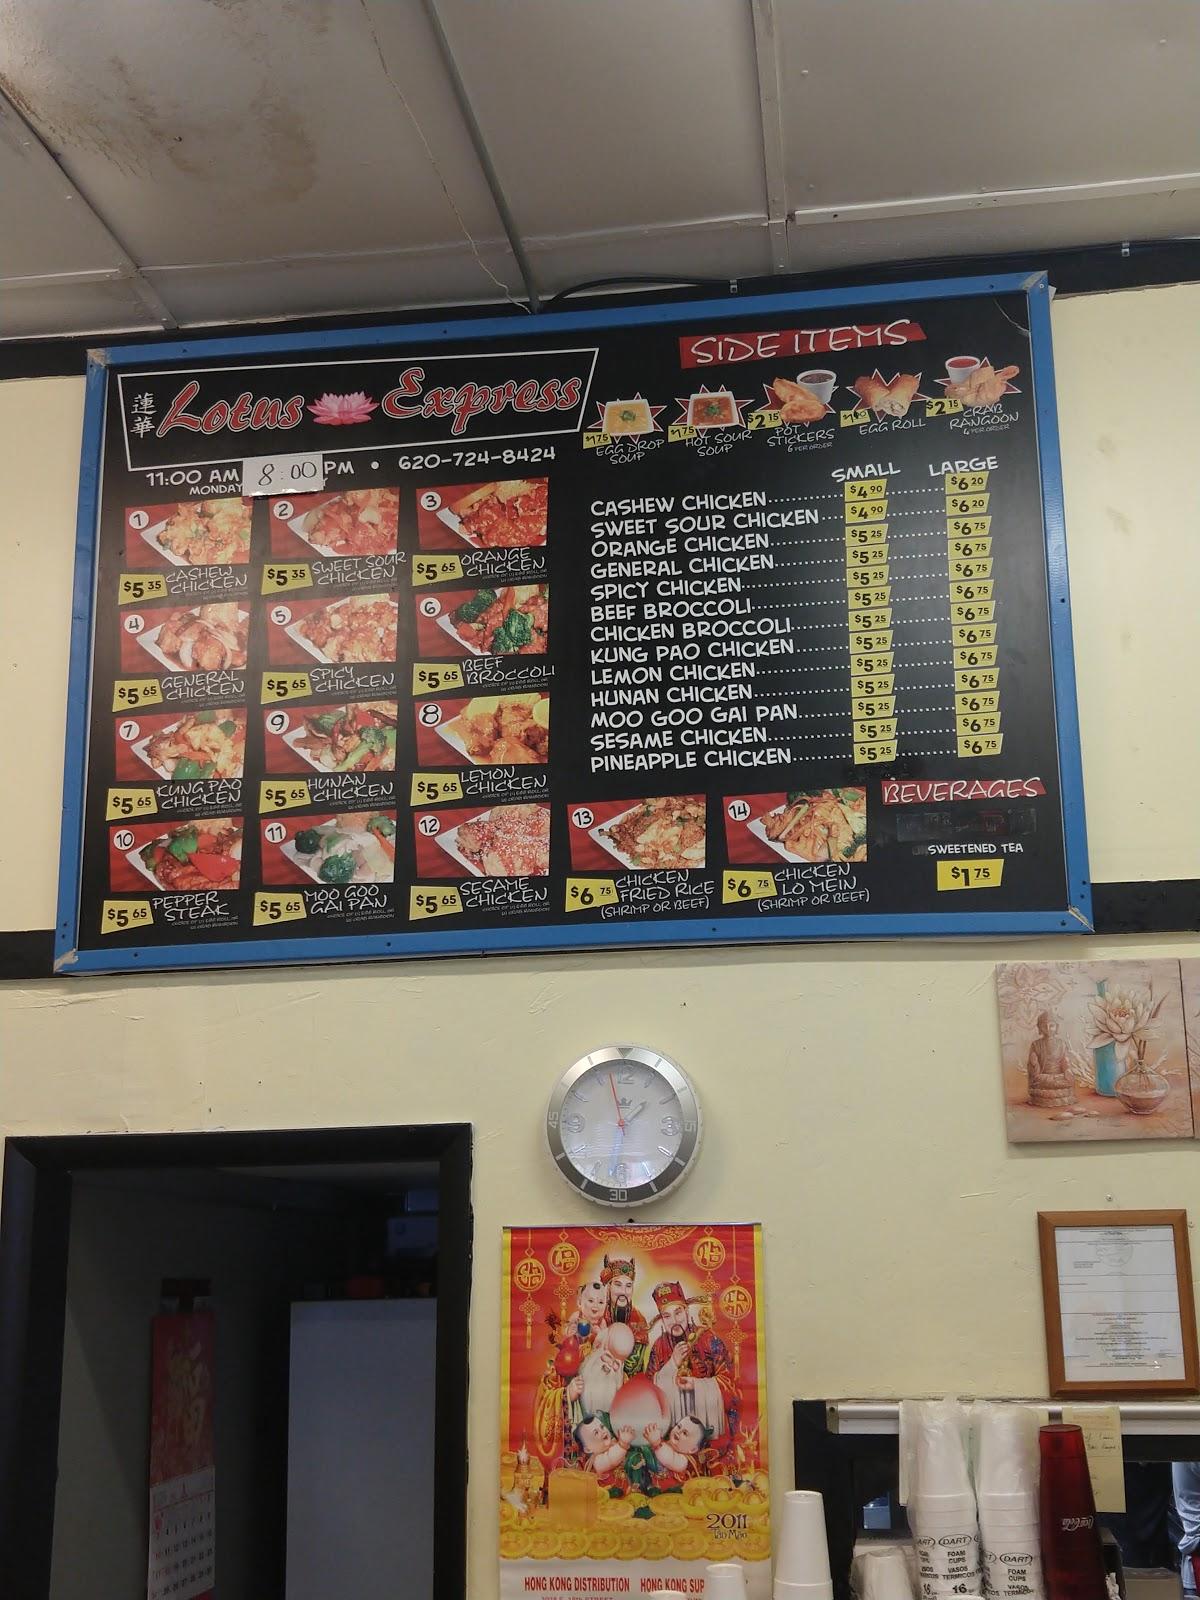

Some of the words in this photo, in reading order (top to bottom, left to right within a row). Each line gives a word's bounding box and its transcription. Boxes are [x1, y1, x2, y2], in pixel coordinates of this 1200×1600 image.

[691, 333, 780, 364] SIDE
[794, 319, 911, 353] ITEMS
[156, 381, 304, 437] Lotus
[382, 367, 582, 435] Express
[963, 403, 1003, 418] CRAB
[775, 424, 800, 437] POT
[860, 422, 888, 435] EGG
[892, 419, 926, 431] ROLL
[950, 413, 1019, 430] RANGOON
[686, 435, 711, 447] HOT
[714, 430, 752, 443] SOUR
[766, 429, 835, 447] STICKERS
[596, 444, 625, 456] EGG
[628, 439, 665, 453] DROP
[697, 444, 733, 457] SOUP
[787, 444, 794, 453] 6
[398, 446, 556, 470] 620-724-8424
[610, 451, 645, 464] SOUP
[929, 456, 999, 477] LARGE
[146, 470, 201, 487] 11:00
[209, 469, 240, 483] AM
[325, 461, 354, 475] PM
[831, 462, 901, 483] SMALL
[189, 483, 243, 496] MONDAY
[278, 503, 288, 516] 2
[424, 495, 437, 508] 3
[590, 497, 675, 517] CASHEW
[682, 491, 767, 511] CHICKEN
[134, 514, 143, 526] 1
[590, 519, 657, 539] SWEET
[665, 515, 726, 534] SOUR
[733, 509, 819, 529] CHICKEN
[591, 538, 677, 558] ORANGE
[684, 533, 770, 553] CHICKEN
[312, 558, 362, 574] SWEET
[366, 552, 407, 567] SOUR
[461, 547, 530, 565] ORANGE
[166, 567, 232, 582] CASHEW
[318, 566, 395, 585] CHICKEN
[466, 557, 545, 576] CHICKEN
[590, 560, 682, 579] GENERAL
[688, 554, 774, 574] CHICKEN
[171, 575, 247, 594] CHICKEN
[590, 581, 650, 602] SPICY
[656, 577, 742, 597] CHICKEN
[275, 610, 286, 623] 5
[424, 601, 436, 614] 6
[590, 604, 636, 623] BEEF
[643, 599, 751, 620] BROCCOLI
[128, 618, 139, 630] 4
[590, 623, 675, 642] CHICKEN
[682, 617, 791, 640] BROCCOLI
[590, 647, 648, 664] KUNG
[656, 643, 700, 662] PAO
[708, 638, 794, 658] CHICKEN
[462, 656, 504, 671] BEEF
[162, 671, 239, 688] GENERAL
[310, 667, 354, 681] SPICY
[315, 673, 394, 692] CHICKEN
[467, 666, 555, 685] BROCCOLI
[591, 666, 662, 686] LEMON
[669, 662, 755, 682] CHICKEN
[166, 681, 244, 700] CHICKEN
[590, 688, 659, 707] HUNAN
[666, 684, 752, 703] CHICKEN
[270, 714, 284, 732] 9
[422, 704, 439, 724] 8
[590, 711, 643, 728] MOO
[651, 707, 703, 727] GOO
[710, 706, 747, 723] GAI
[756, 703, 798, 722] PAN
[123, 724, 133, 738] 7
[590, 730, 674, 751] SESAME
[681, 726, 767, 746] CHICKEN
[590, 751, 697, 773] PINEAPPLE
[704, 748, 792, 767] CHICKEN
[307, 773, 366, 790] HUNAN
[461, 766, 515, 783] LEMON
[157, 781, 203, 797] KUNG
[209, 779, 242, 792] PAO
[313, 782, 393, 802] CHICKEN
[466, 775, 547, 795] CHICKEN
[884, 777, 1040, 803] BEVERAGES
[161, 789, 241, 809] CHICKEN
[573, 811, 592, 826] 13
[729, 803, 748, 819] 14
[267, 826, 283, 841] 11
[420, 818, 438, 833] 12
[116, 833, 133, 847] 10
[927, 843, 997, 855] SWEETENED
[1001, 843, 1024, 853] TEA
[616, 869, 689, 888] CHICKEN
[775, 863, 851, 882] CHICKEN
[304, 889, 340, 902] MOO
[344, 885, 379, 898] GOO
[460, 877, 529, 896] SESAME
[620, 886, 671, 902] FRIED
[675, 881, 715, 897] RICE
[783, 883, 805, 896] LO
[809, 876, 857, 893] MEIN
[152, 891, 219, 909] PEPPER
[311, 901, 343, 914] GAI
[348, 895, 387, 911] PAN
[466, 887, 548, 908] CHICKEN
[757, 897, 808, 912] (SHRIMP
[811, 894, 830, 906] OR
[832, 888, 870, 903] BEEF)
[165, 903, 229, 921] STEAK
[601, 904, 650, 919] (SHRIMP
[653, 901, 671, 912] OR
[674, 896, 710, 910] BEEF)
[548, 1112, 559, 1128] 45
[610, 1190, 628, 1201] 30
[706, 1513, 747, 1529] 2011
[943, 1537, 967, 1545] DART
[524, 1577, 548, 1591] HONG
[549, 1578, 572, 1591] KONG
[575, 1577, 630, 1592] DISTRIBUTION
[942, 1572, 975, 1580] TERMICOS
[640, 1578, 663, 1592] HONG
[665, 1578, 687, 1593] KONG
[952, 1583, 967, 1594] 16
